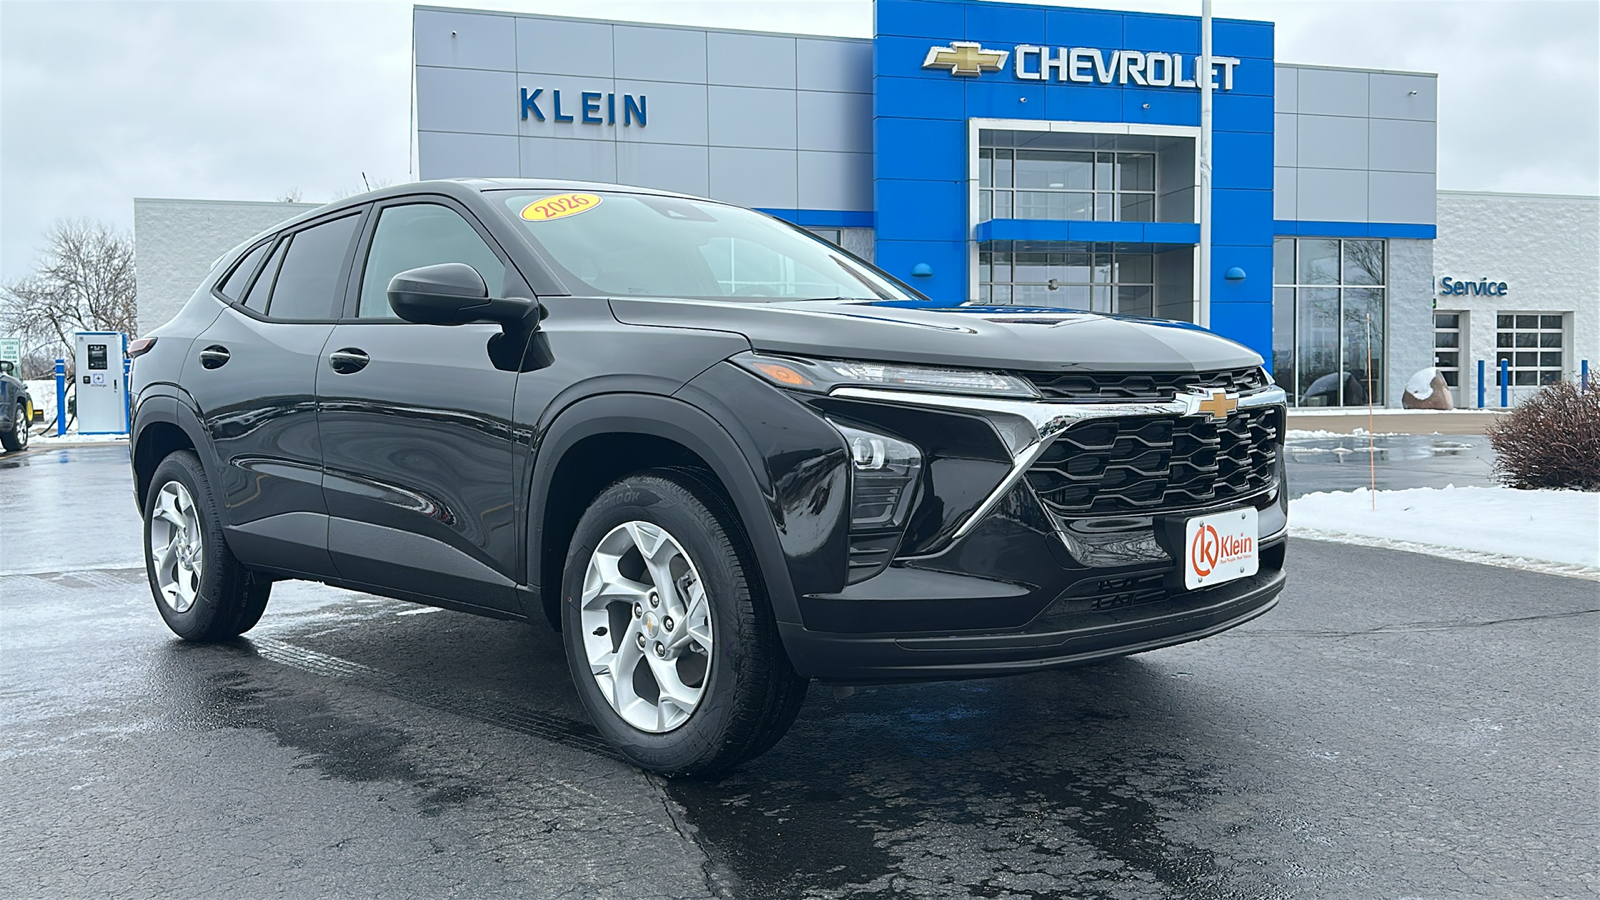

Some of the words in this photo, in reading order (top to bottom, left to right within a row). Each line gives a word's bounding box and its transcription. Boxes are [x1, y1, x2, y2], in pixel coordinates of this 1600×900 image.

[1014, 44, 1241, 91] CHEVROLET
[520, 87, 648, 127] KLEIN
[534, 194, 590, 219] 2026
[1441, 276, 1508, 297] Service
[1221, 532, 1252, 558] Klein
